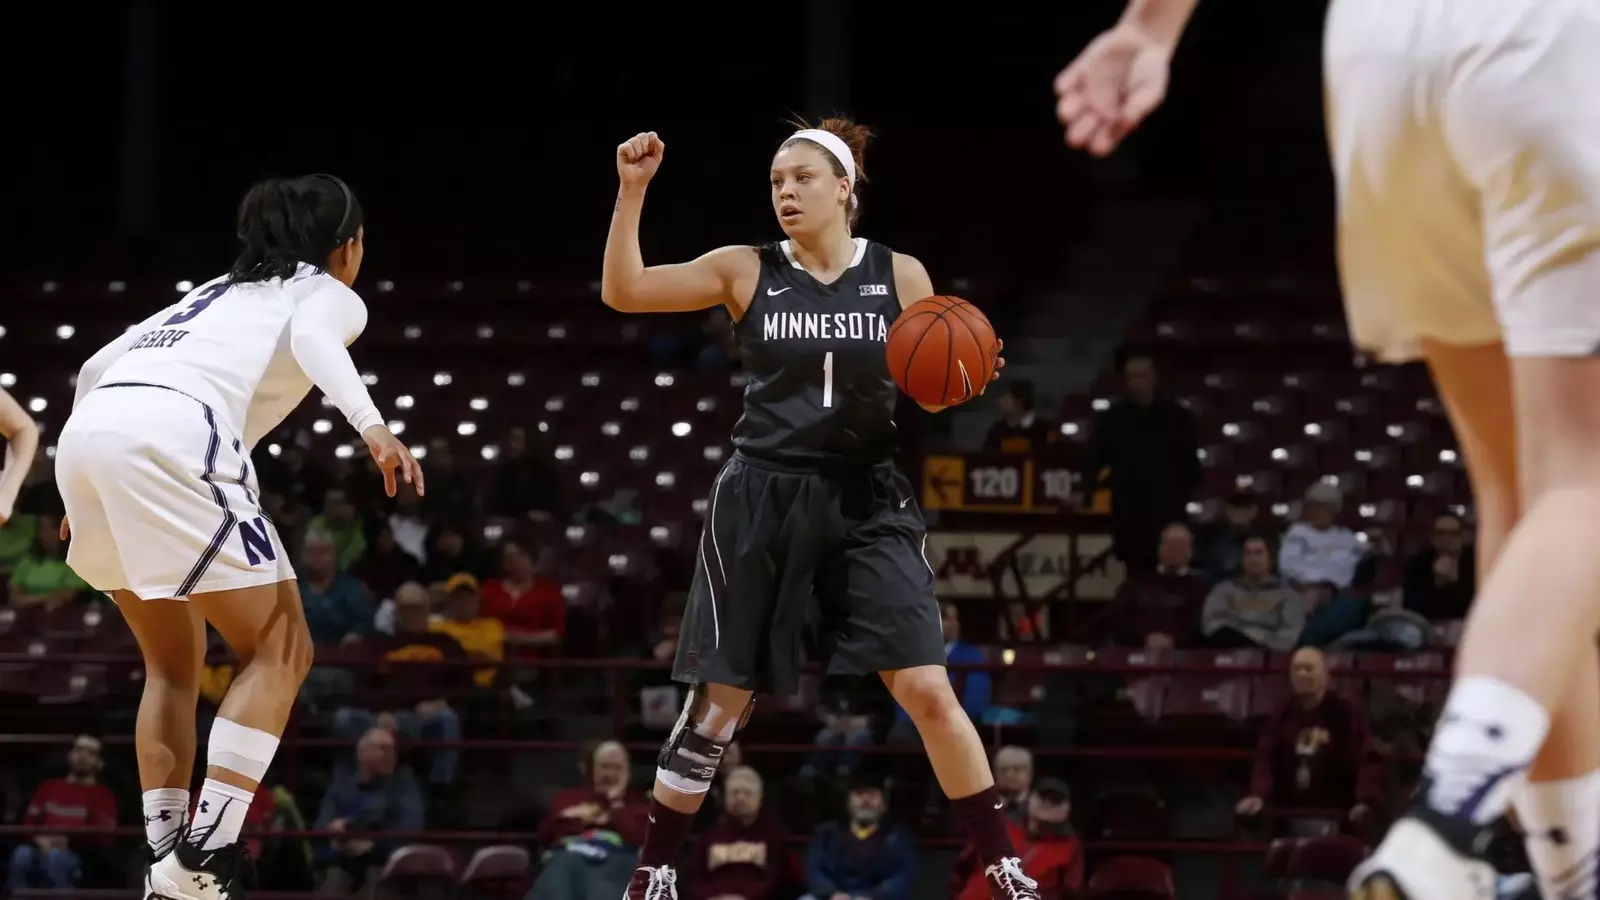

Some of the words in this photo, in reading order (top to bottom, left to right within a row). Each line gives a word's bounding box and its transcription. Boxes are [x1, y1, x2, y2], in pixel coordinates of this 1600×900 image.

[161, 282, 233, 326] 3
[764, 312, 887, 343] MINNESOTA
[823, 351, 833, 408] 1
[969, 467, 1018, 498] 120
[238, 517, 276, 566] N
